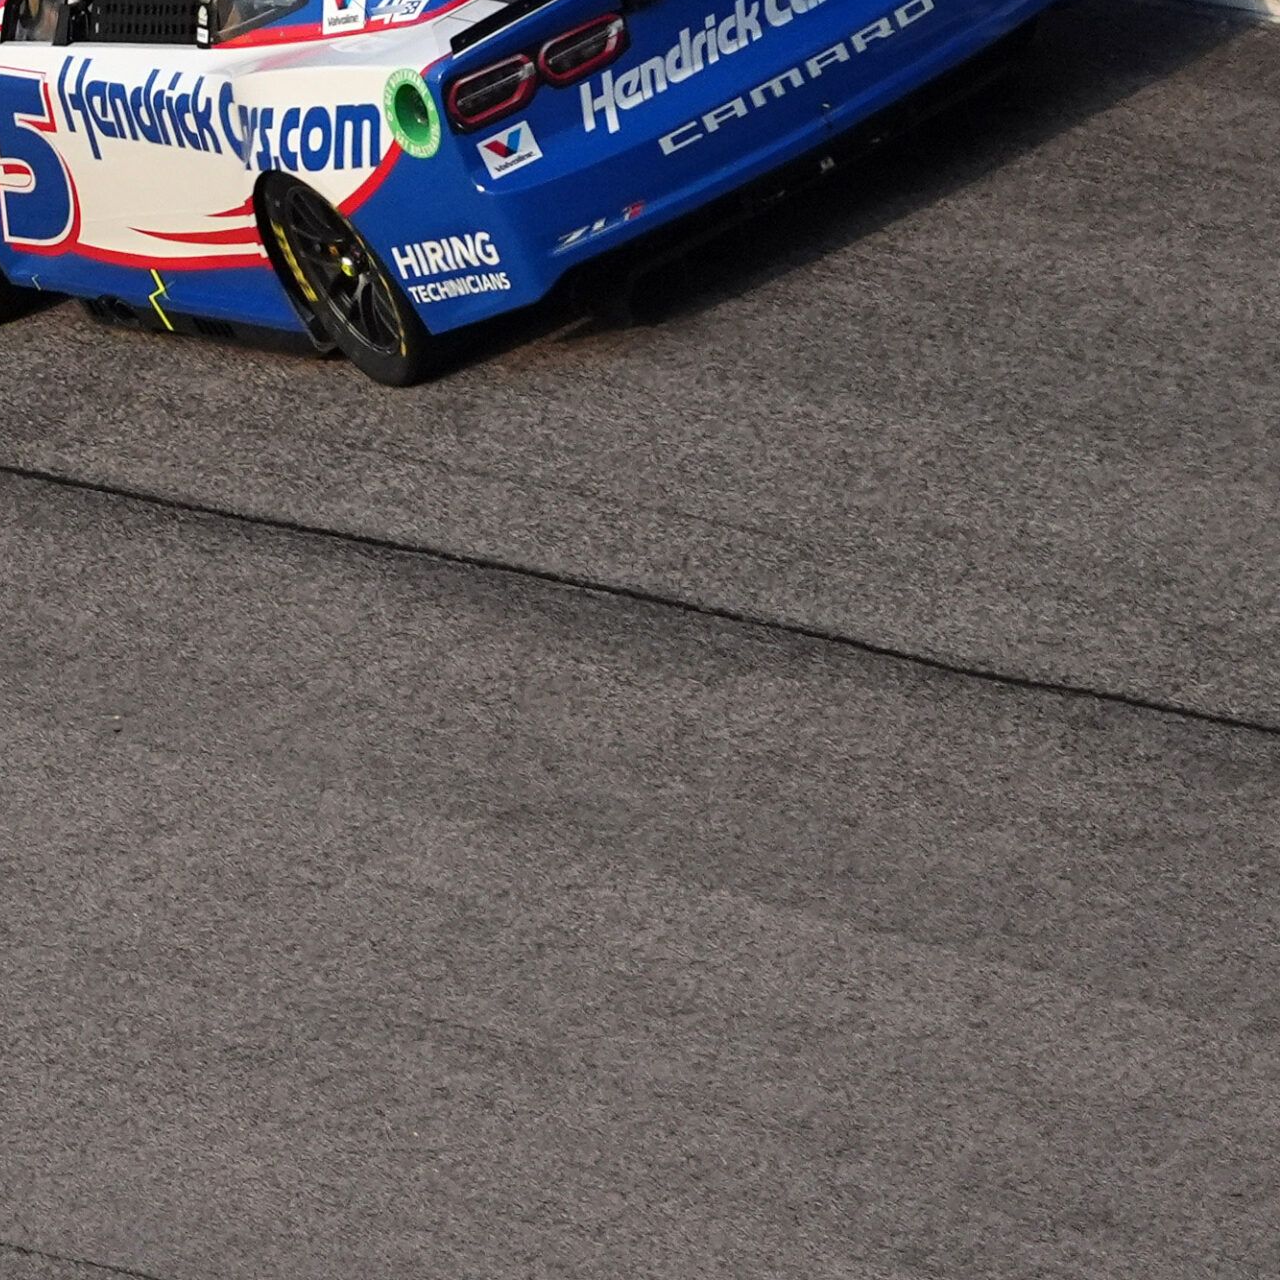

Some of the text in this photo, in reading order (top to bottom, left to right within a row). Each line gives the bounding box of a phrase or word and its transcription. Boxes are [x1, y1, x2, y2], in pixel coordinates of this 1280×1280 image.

[327, 13, 360, 28] Valvoline
[494, 150, 535, 172] Valvoline
[391, 231, 501, 280] HIRING
[407, 272, 511, 304] TECHNICIANS
